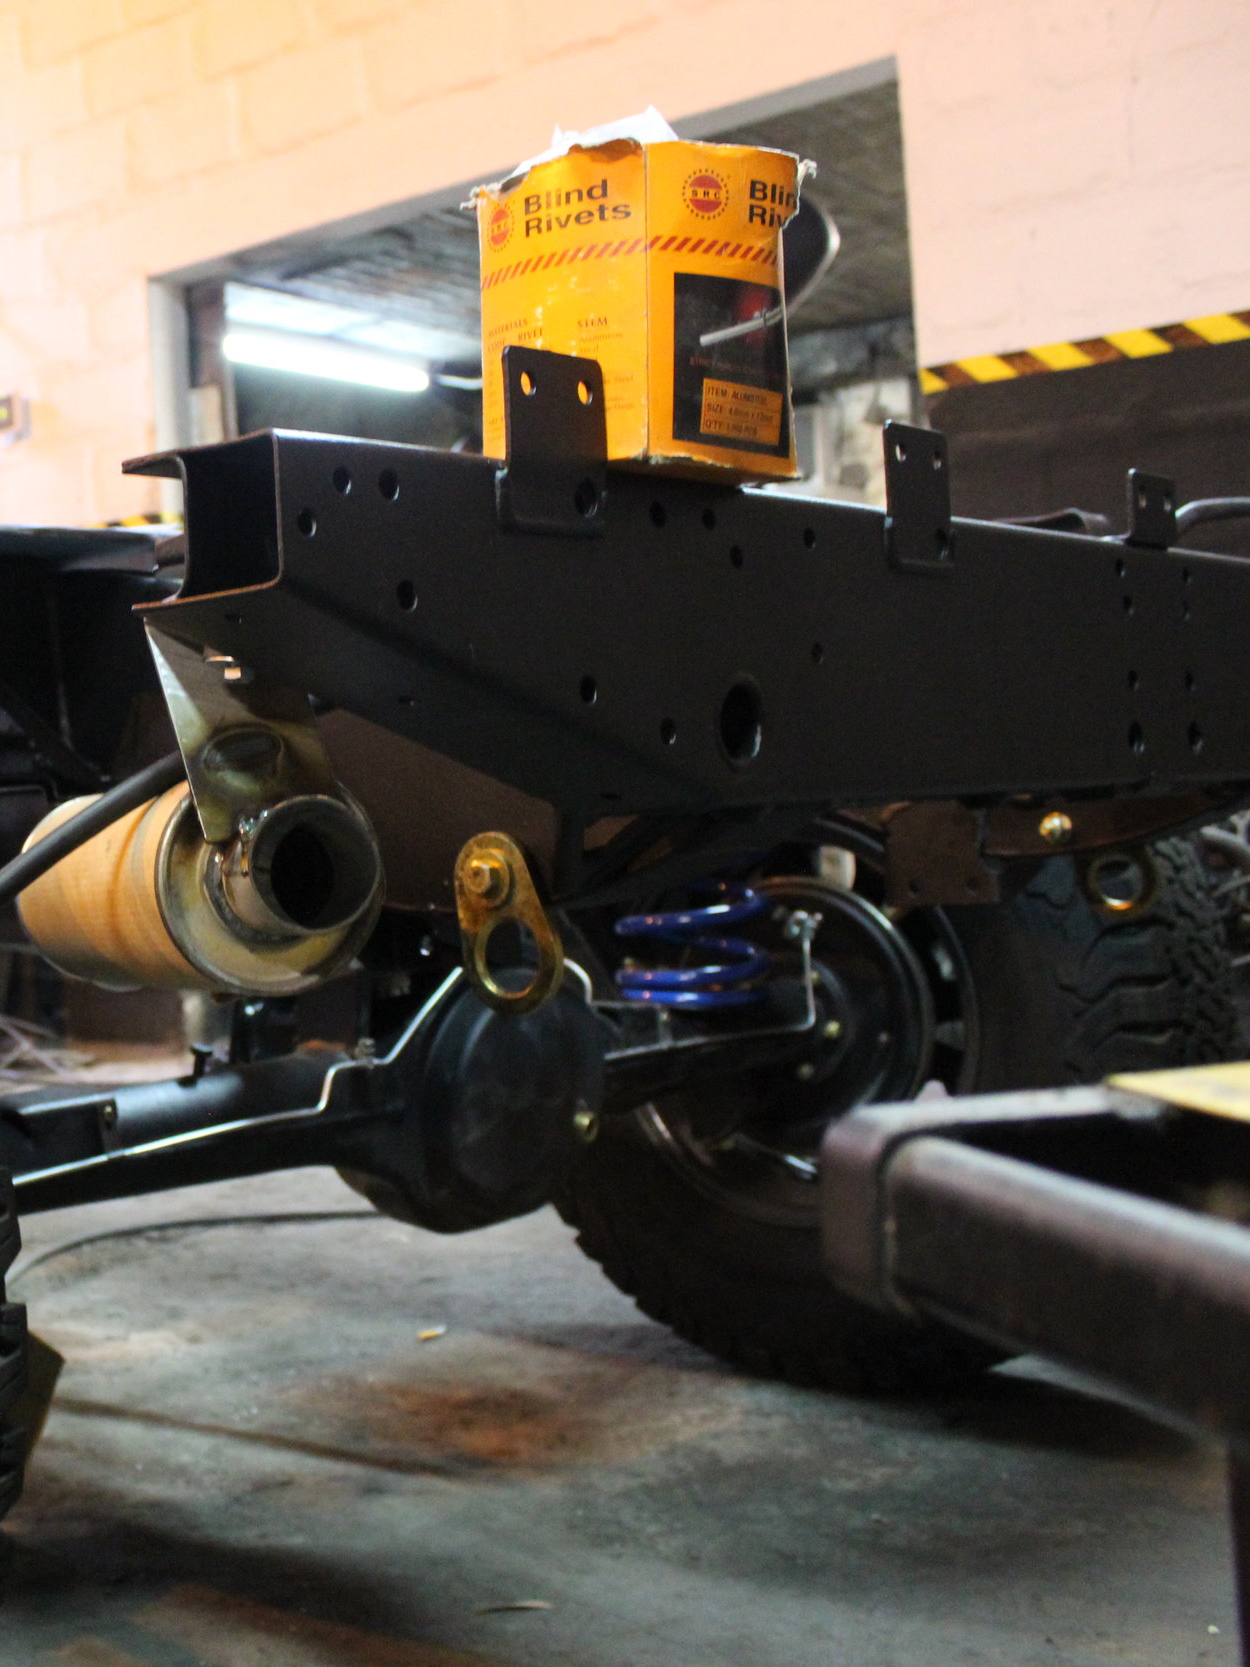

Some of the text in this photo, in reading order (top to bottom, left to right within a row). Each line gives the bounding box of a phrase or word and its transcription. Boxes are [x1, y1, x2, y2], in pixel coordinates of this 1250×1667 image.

[524, 179, 609, 216] Blind
[524, 203, 632, 238] Rivets
[517, 327, 544, 344] RIVET
